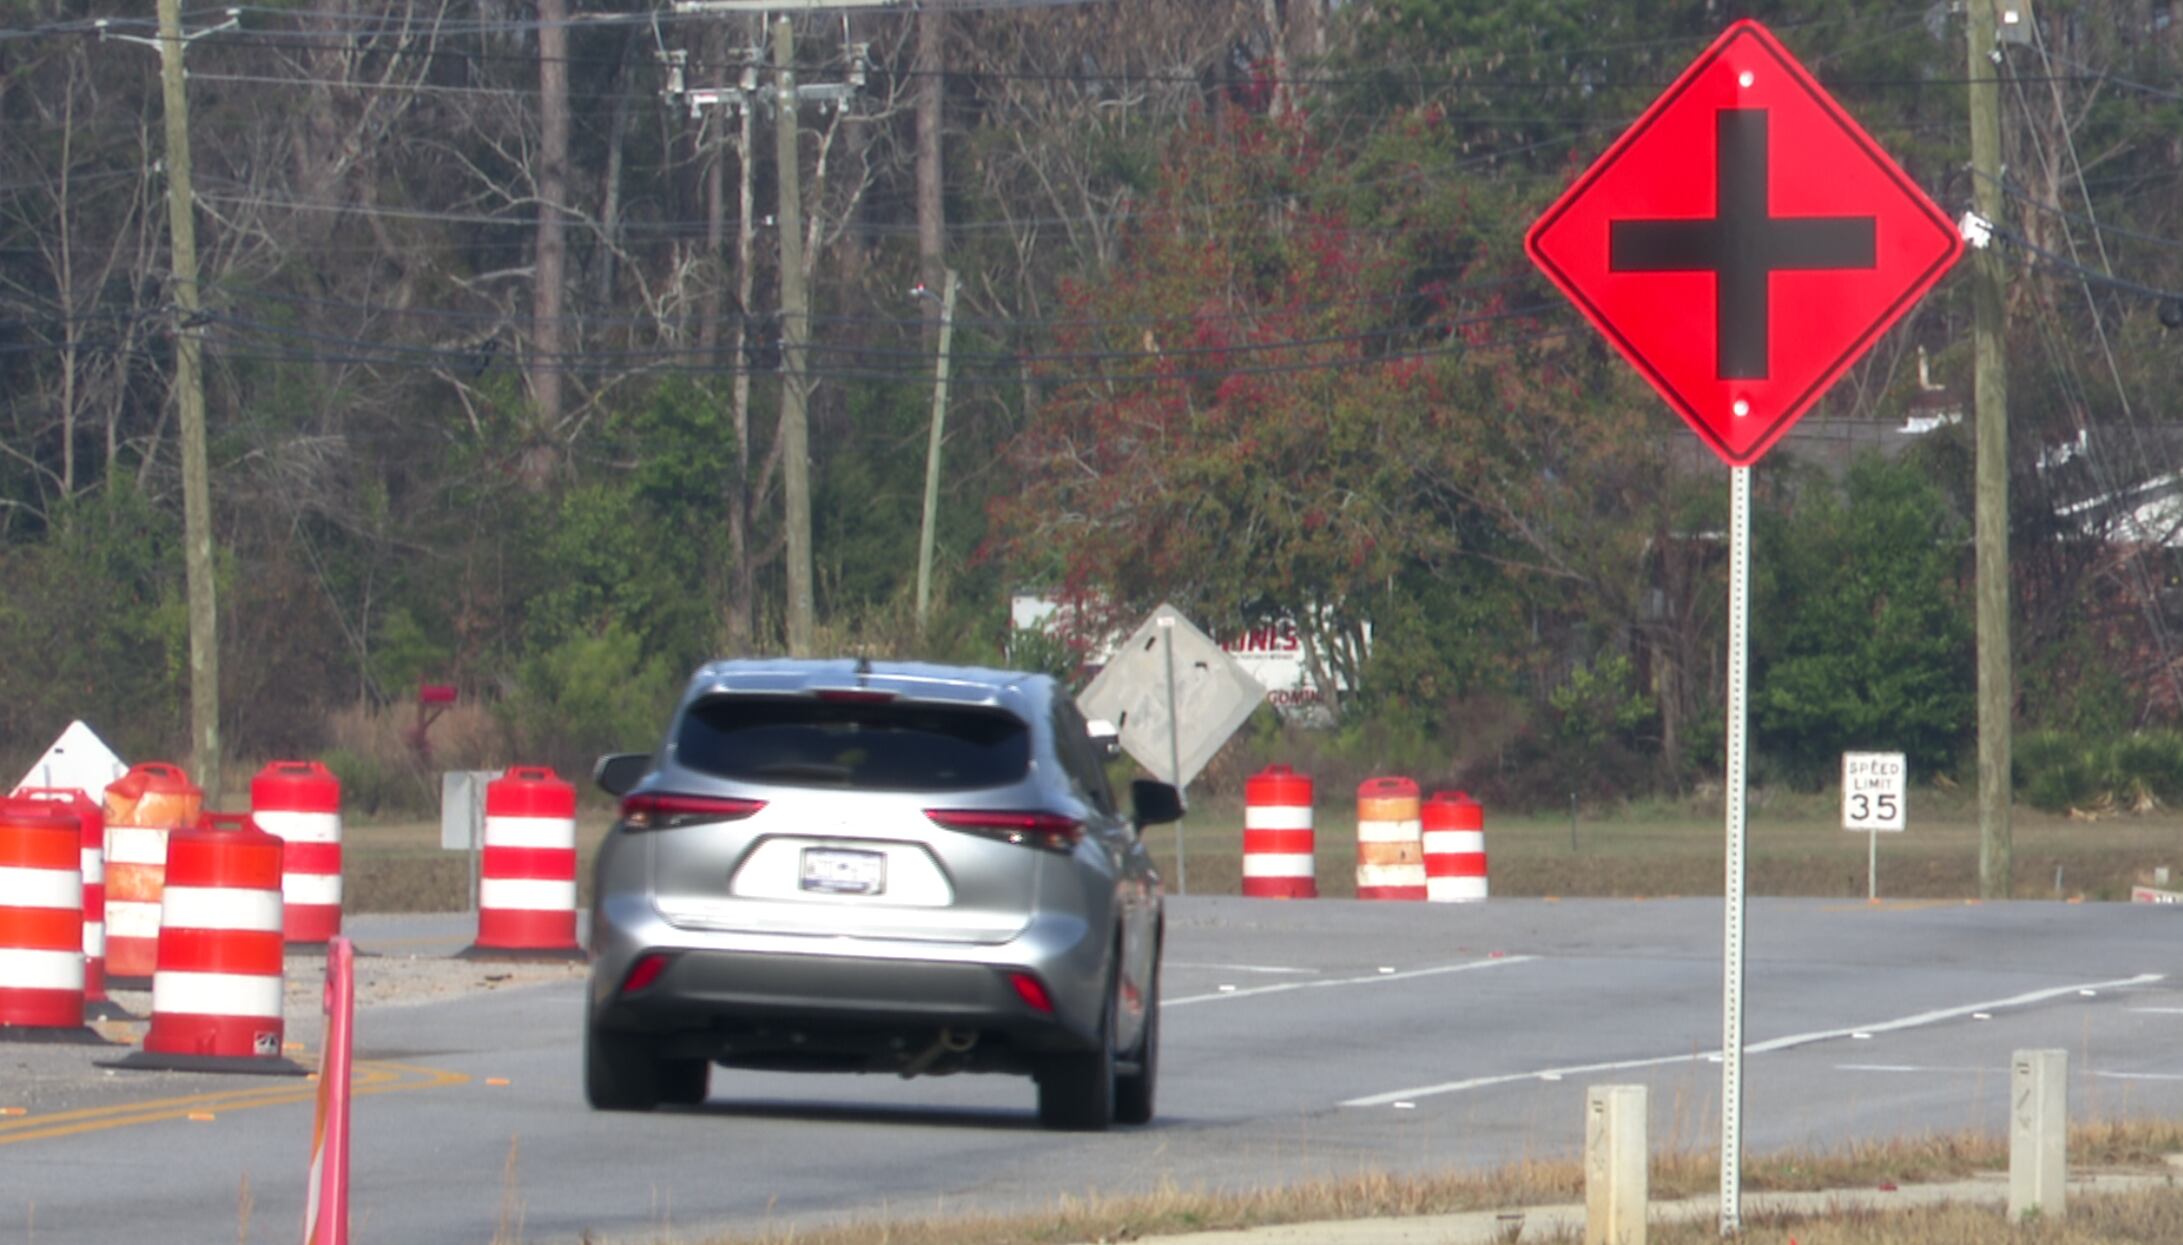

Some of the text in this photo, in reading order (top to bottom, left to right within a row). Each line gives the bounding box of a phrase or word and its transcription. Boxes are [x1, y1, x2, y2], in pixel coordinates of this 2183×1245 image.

[1849, 760, 1900, 775] SPEED
[1854, 779, 1892, 790] LIMIT
[1850, 794, 1897, 820] 35
